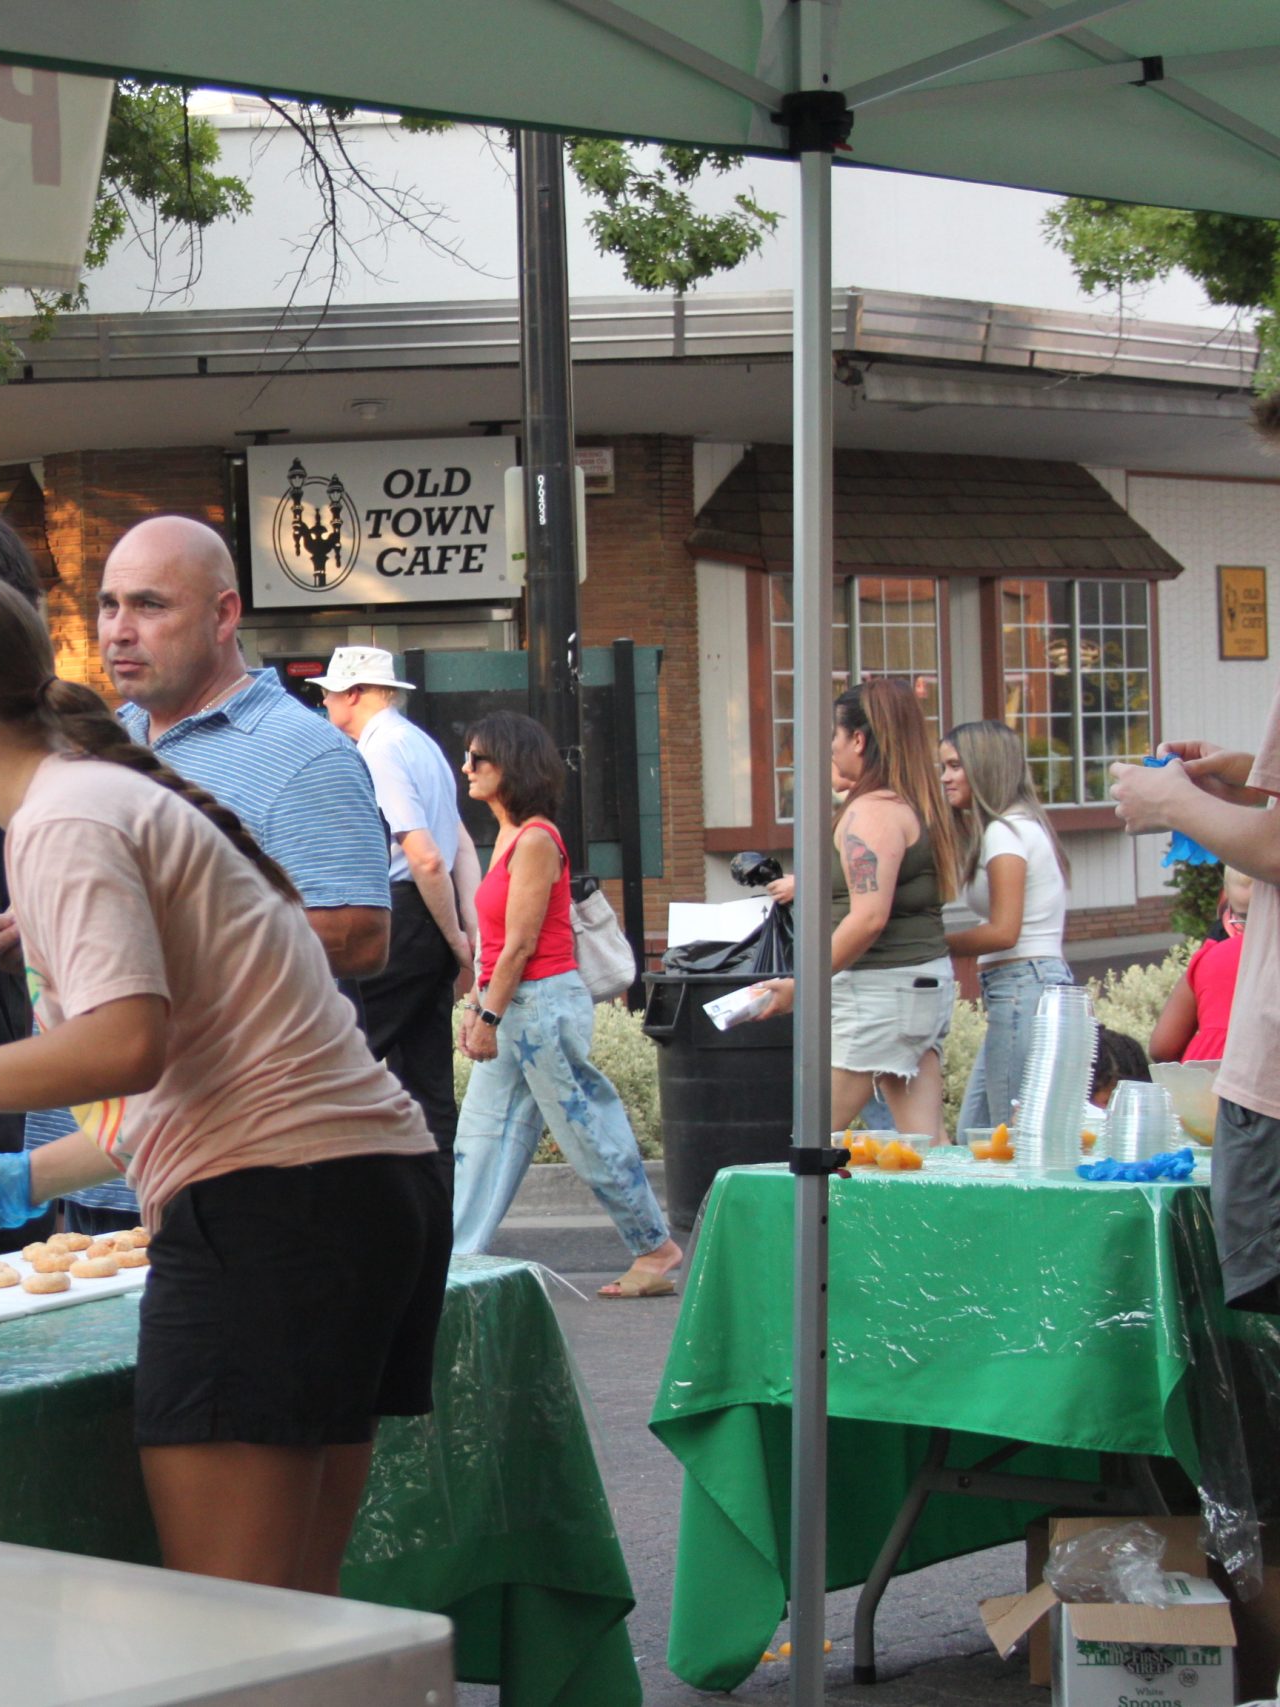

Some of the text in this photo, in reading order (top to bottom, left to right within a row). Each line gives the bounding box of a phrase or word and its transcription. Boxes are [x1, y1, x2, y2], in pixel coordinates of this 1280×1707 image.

[383, 467, 472, 499] OLD
[365, 504, 495, 539] TOWN
[376, 544, 487, 577] CAFE
[1132, 1650, 1164, 1662] FIRST
[1127, 1663, 1169, 1674] STREET
[1135, 1687, 1164, 1696] White
[1118, 1696, 1182, 1707] Spoons
